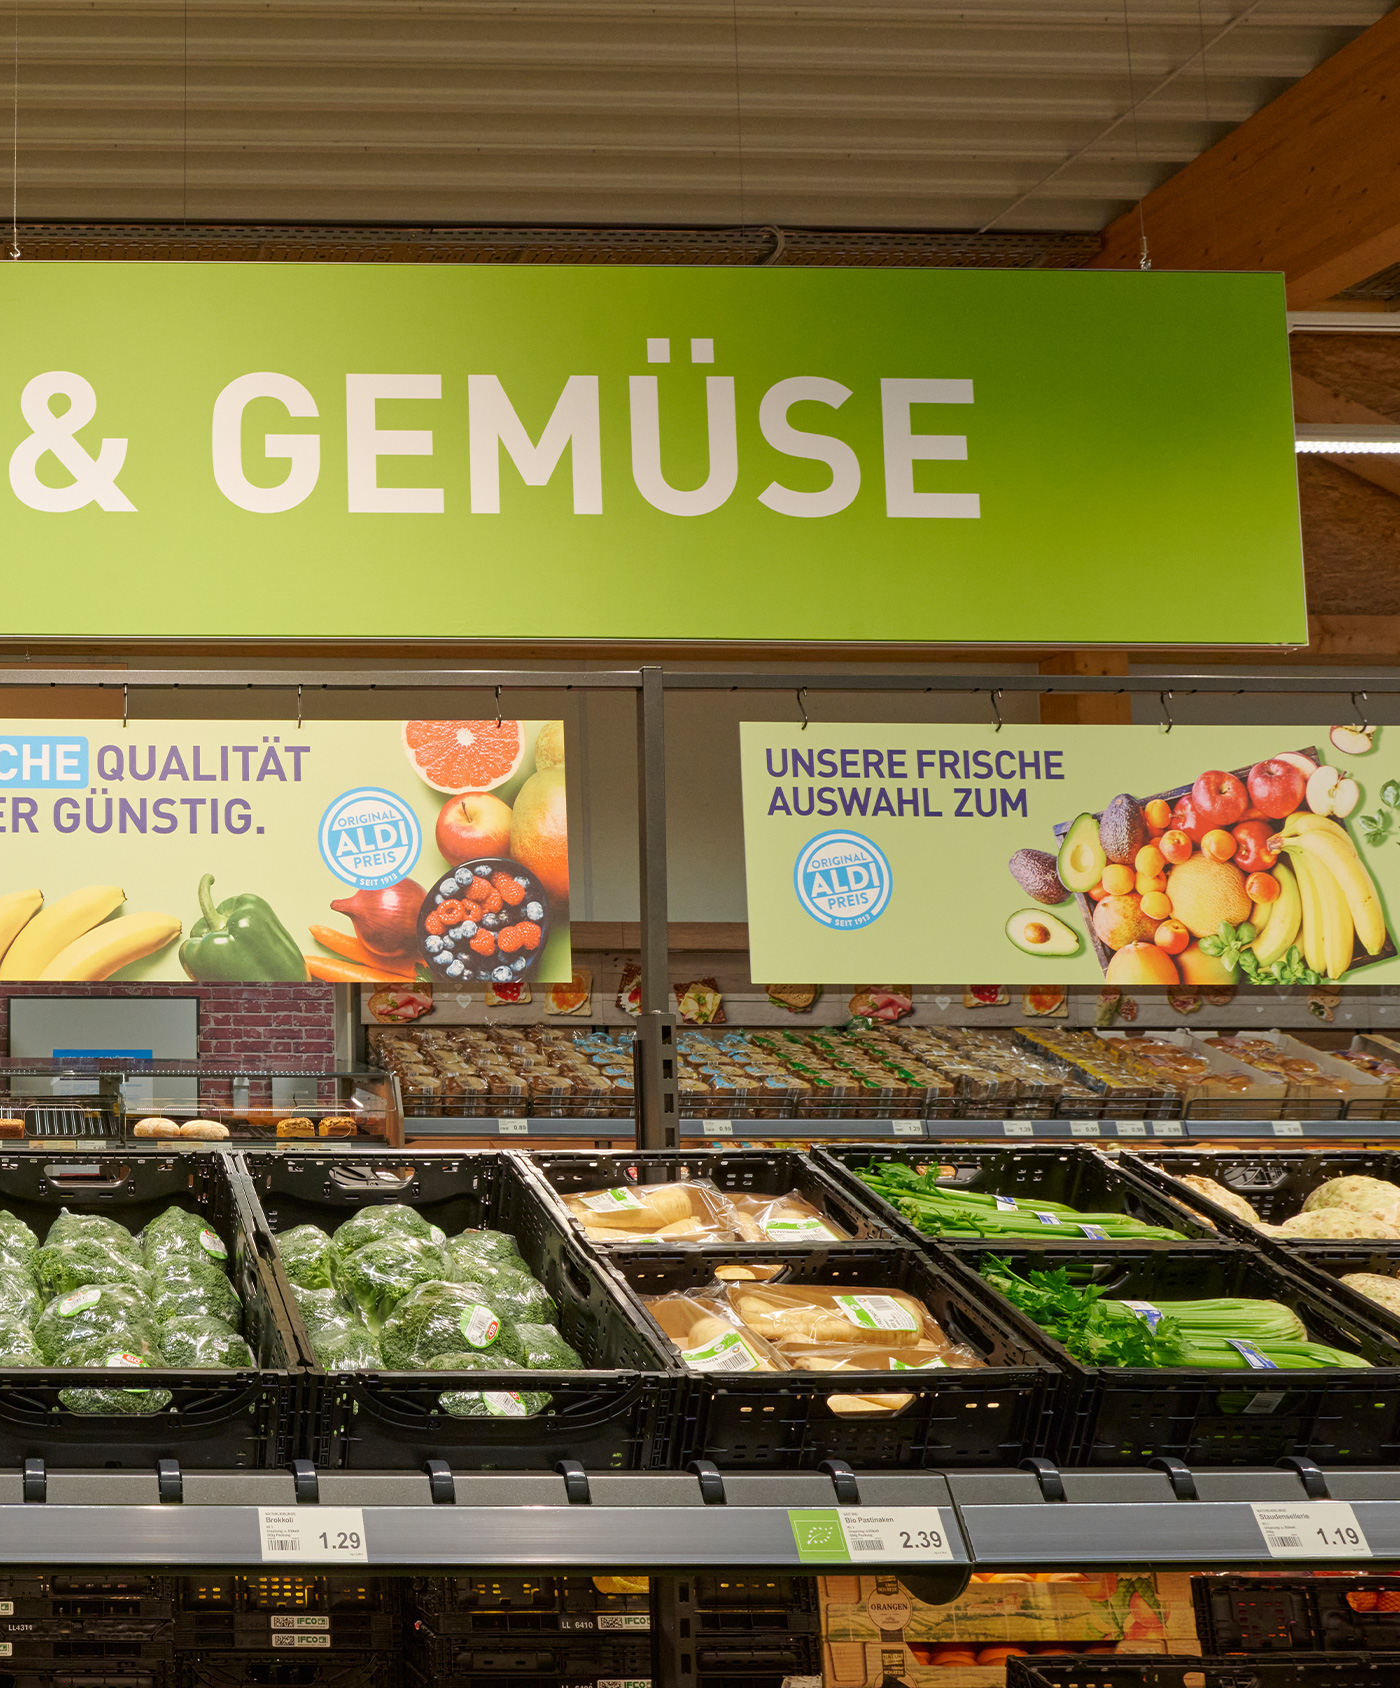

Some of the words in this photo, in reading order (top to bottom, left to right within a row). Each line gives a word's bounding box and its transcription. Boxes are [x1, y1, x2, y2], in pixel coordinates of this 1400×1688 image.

[9, 370, 139, 513] &
[211, 338, 982, 519] GEMÜSE
[97, 736, 310, 782] QUALITÄT
[766, 748, 908, 779] UNSERE
[916, 750, 1065, 780] FRISCHE
[767, 786, 943, 817] AUSWAHL
[954, 787, 1028, 818] ZUM
[53, 788, 265, 835] GÜNSTIG.
[338, 810, 396, 827] ORIGINAL
[336, 820, 409, 857] ALDI
[353, 851, 396, 869] PREIS
[811, 852, 867, 870] ORIGINAL
[360, 878, 378, 886] SEIT
[381, 873, 398, 885] 1913
[811, 862, 880, 898] ALDI
[828, 893, 869, 910] PREIS
[834, 918, 853, 927] SEIT
[854, 914, 871, 926] 1913
[319, 1532, 361, 1549] 1.29
[900, 1531, 942, 1548] 2.39
[1317, 1528, 1359, 1545] 1.19
[870, 1603, 908, 1611] ORANGEN
[575, 1621, 593, 1629] 6410
